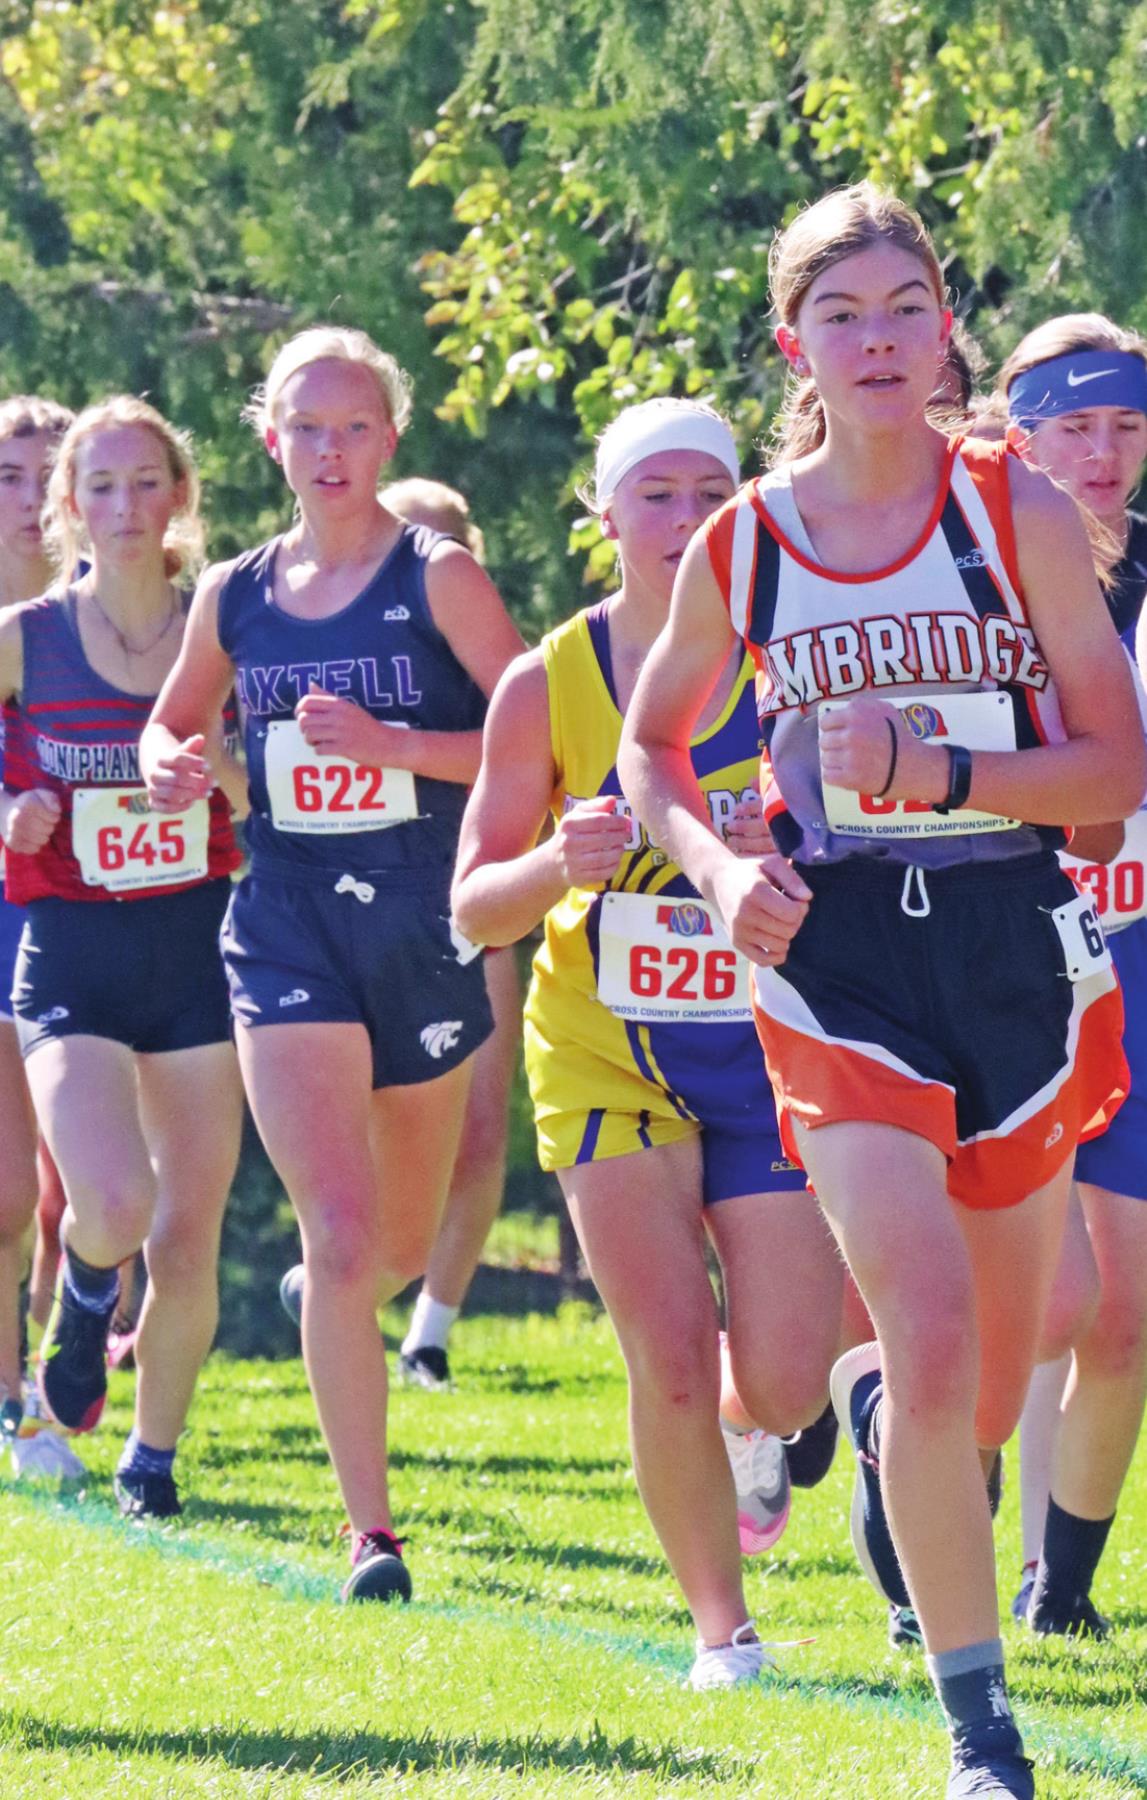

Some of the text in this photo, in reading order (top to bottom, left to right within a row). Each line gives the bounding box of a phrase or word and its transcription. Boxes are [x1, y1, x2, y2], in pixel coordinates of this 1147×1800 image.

[757, 611, 1048, 720] MBRIDGE
[293, 765, 386, 812] 622
[97, 819, 185, 870] 645
[842, 818, 1005, 834] CROSS COUNTRY CHAMPIONSHIPS
[1061, 860, 1144, 916] 30
[1078, 903, 1104, 959] 6
[629, 945, 737, 1001] 626
[611, 1004, 753, 1018] CROSS COUNTRY CHAMPIONSHIPS
